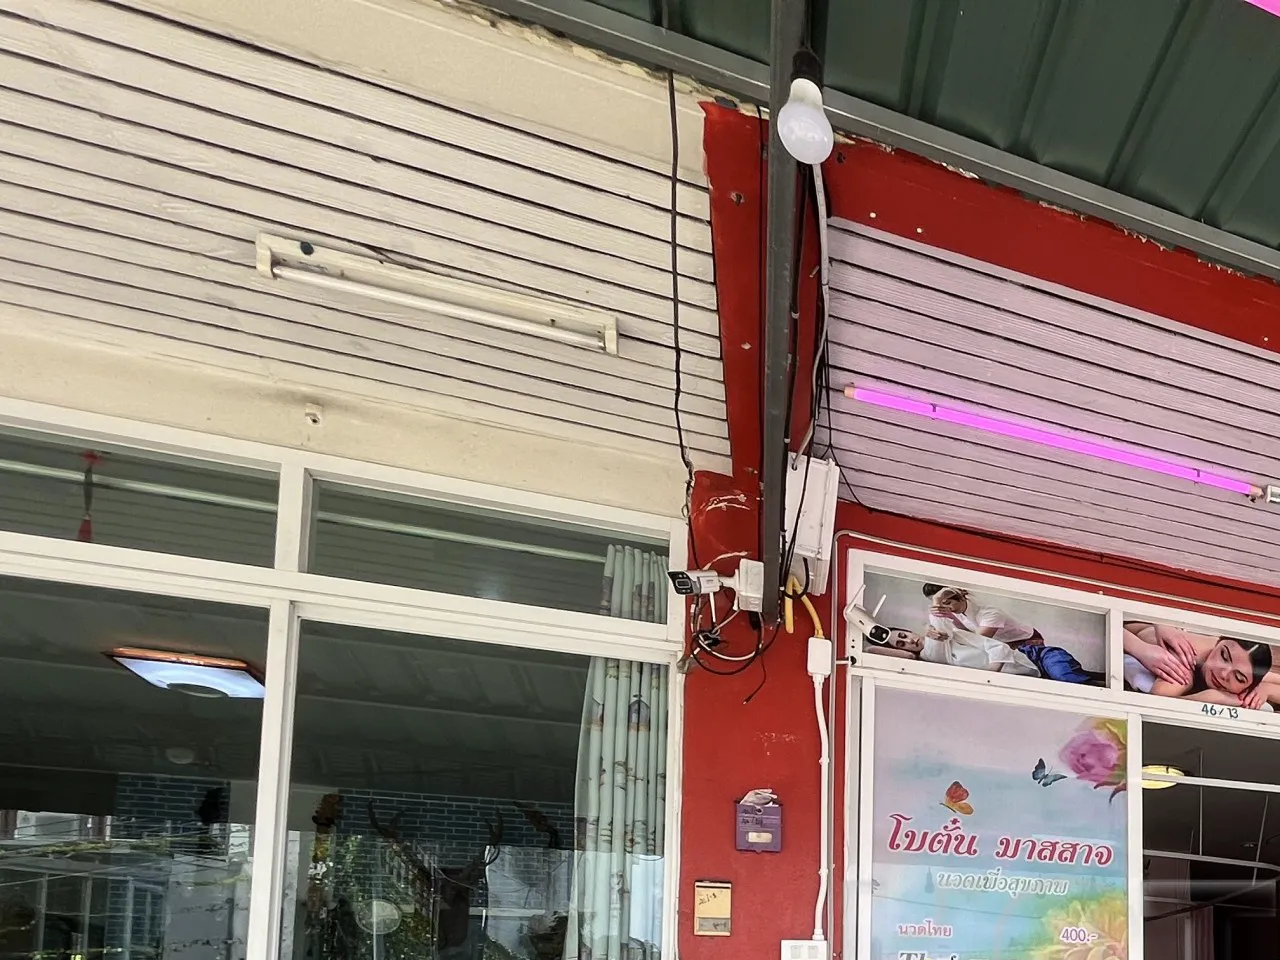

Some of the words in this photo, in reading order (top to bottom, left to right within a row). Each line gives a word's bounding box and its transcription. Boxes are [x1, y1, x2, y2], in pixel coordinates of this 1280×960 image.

[1201, 703, 1239, 719] 46/13
[888, 813, 978, 856] โบตั๋น
[996, 834, 1113, 866] มาสสาจ
[936, 868, 1069, 897] นวดเพื่อสุขภาพ
[898, 920, 952, 938] นวดไทย
[1061, 928, 1098, 943] 400.-
